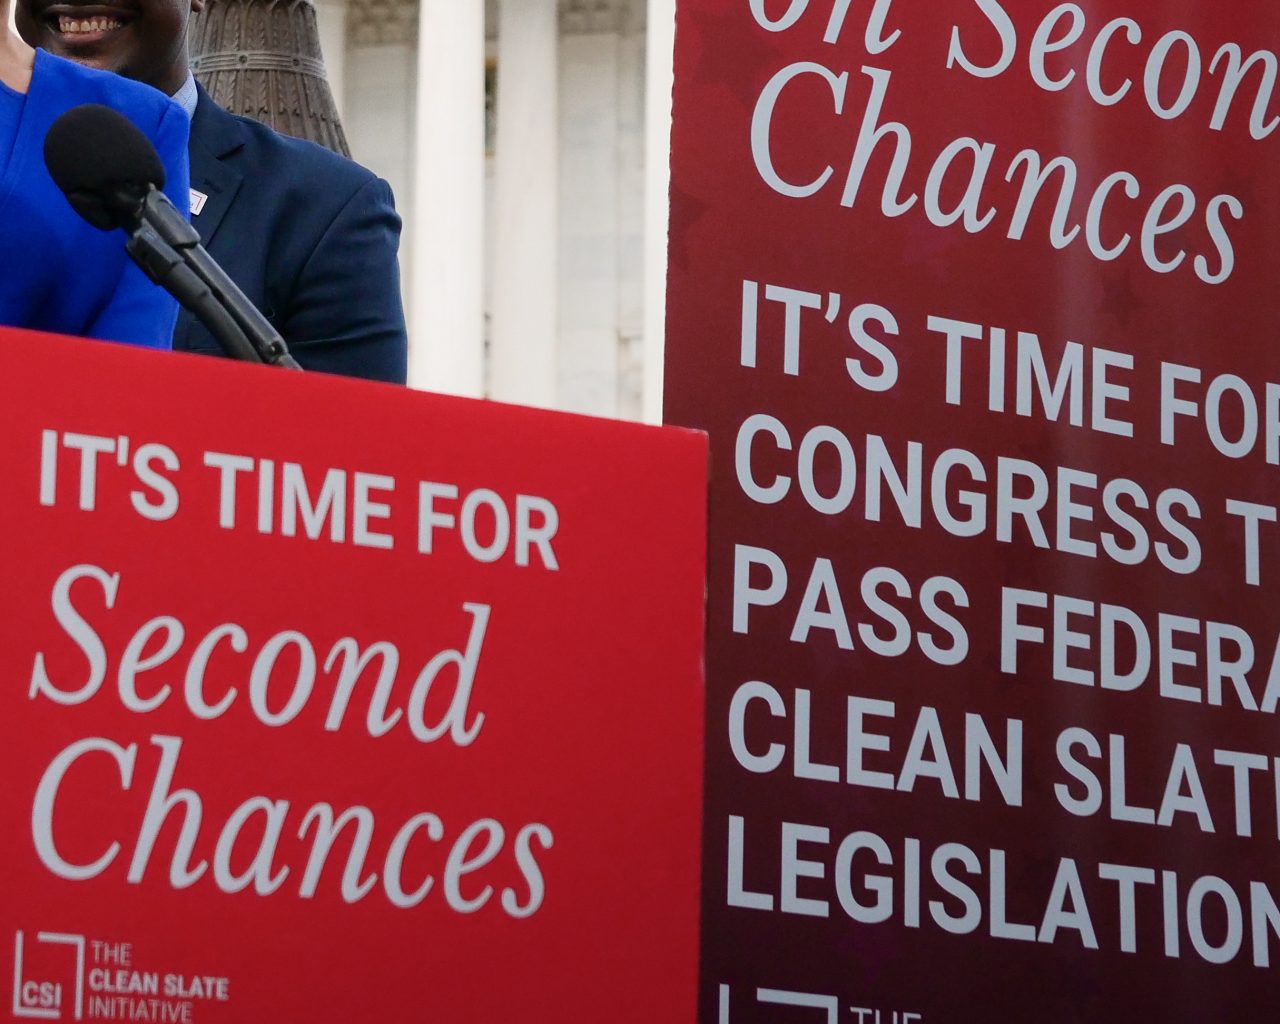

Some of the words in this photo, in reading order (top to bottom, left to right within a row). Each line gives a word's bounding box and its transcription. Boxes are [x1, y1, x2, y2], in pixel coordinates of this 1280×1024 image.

[751, 62, 1243, 284] Chances
[741, 280, 899, 391] IT'S
[927, 315, 1133, 437] TIME
[1161, 362, 1280, 465] FO
[39, 429, 181, 521] IT'S
[203, 452, 396, 549] TIME
[418, 481, 559, 571] FOR
[735, 414, 1201, 574] CONGRESS
[29, 564, 491, 746] Second
[733, 544, 969, 665] PASS
[32, 735, 554, 918] Chances
[729, 681, 1022, 807] CLEAN
[1054, 727, 1280, 841] SLAT
[23, 981, 61, 1008] CSI
[88, 996, 193, 1024] INITIATIVE
[89, 968, 158, 995] CLEAN
[164, 974, 229, 1001] SLATE
[90, 940, 132, 966] THE
